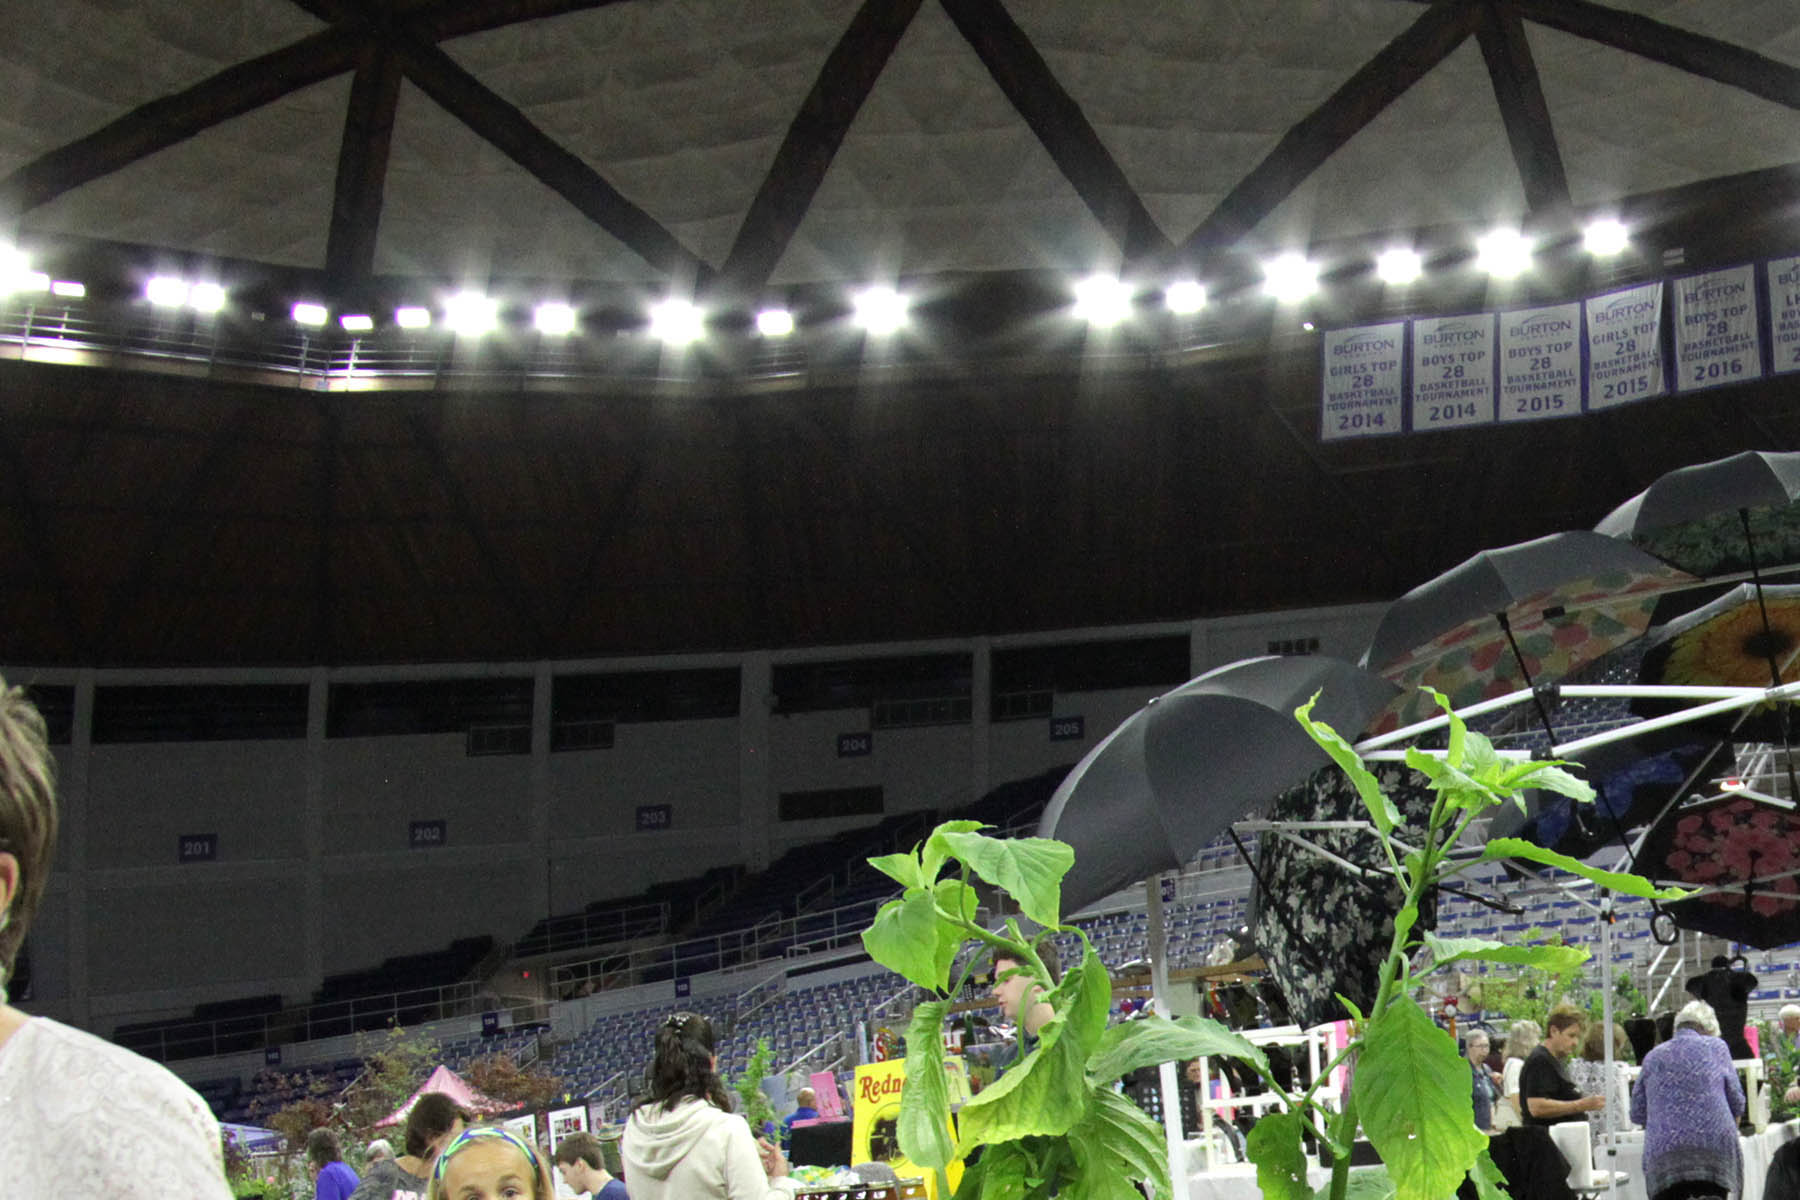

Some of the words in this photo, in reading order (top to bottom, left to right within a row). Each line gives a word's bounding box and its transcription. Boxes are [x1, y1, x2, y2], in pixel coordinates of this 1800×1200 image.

[1685, 283, 1745, 304] BURTON
[1595, 301, 1654, 322] BURTON
[1685, 312, 1717, 325] BOYS
[1721, 304, 1747, 318] TOP
[1510, 320, 1570, 336] BURTON
[1592, 329, 1628, 345] GIRLS
[1634, 322, 1657, 336] TOP
[1707, 322, 1728, 337] 28
[1424, 330, 1484, 345] BURTON
[1334, 340, 1395, 355] BURTON
[1508, 345, 1541, 358] BOYS
[1547, 342, 1572, 353] TOP
[1616, 340, 1636, 355] 28
[1422, 354, 1454, 366] BOYS
[1461, 351, 1485, 361] TOP
[1529, 357, 1551, 370] 28
[1330, 363, 1367, 376] GIRLS
[1372, 360, 1397, 371] TOP
[1443, 365, 1464, 379] 28
[1695, 360, 1742, 380] 2016
[1352, 375, 1374, 388] 28
[1603, 376, 1648, 398] 2015
[1517, 394, 1563, 412] 2015
[1429, 402, 1476, 421] 2014
[1340, 412, 1384, 430] 2014
[1055, 722, 1080, 736] 205
[842, 739, 867, 752] 204
[641, 810, 666, 825] 203
[414, 827, 440, 841] 202
[184, 841, 209, 856] 201
